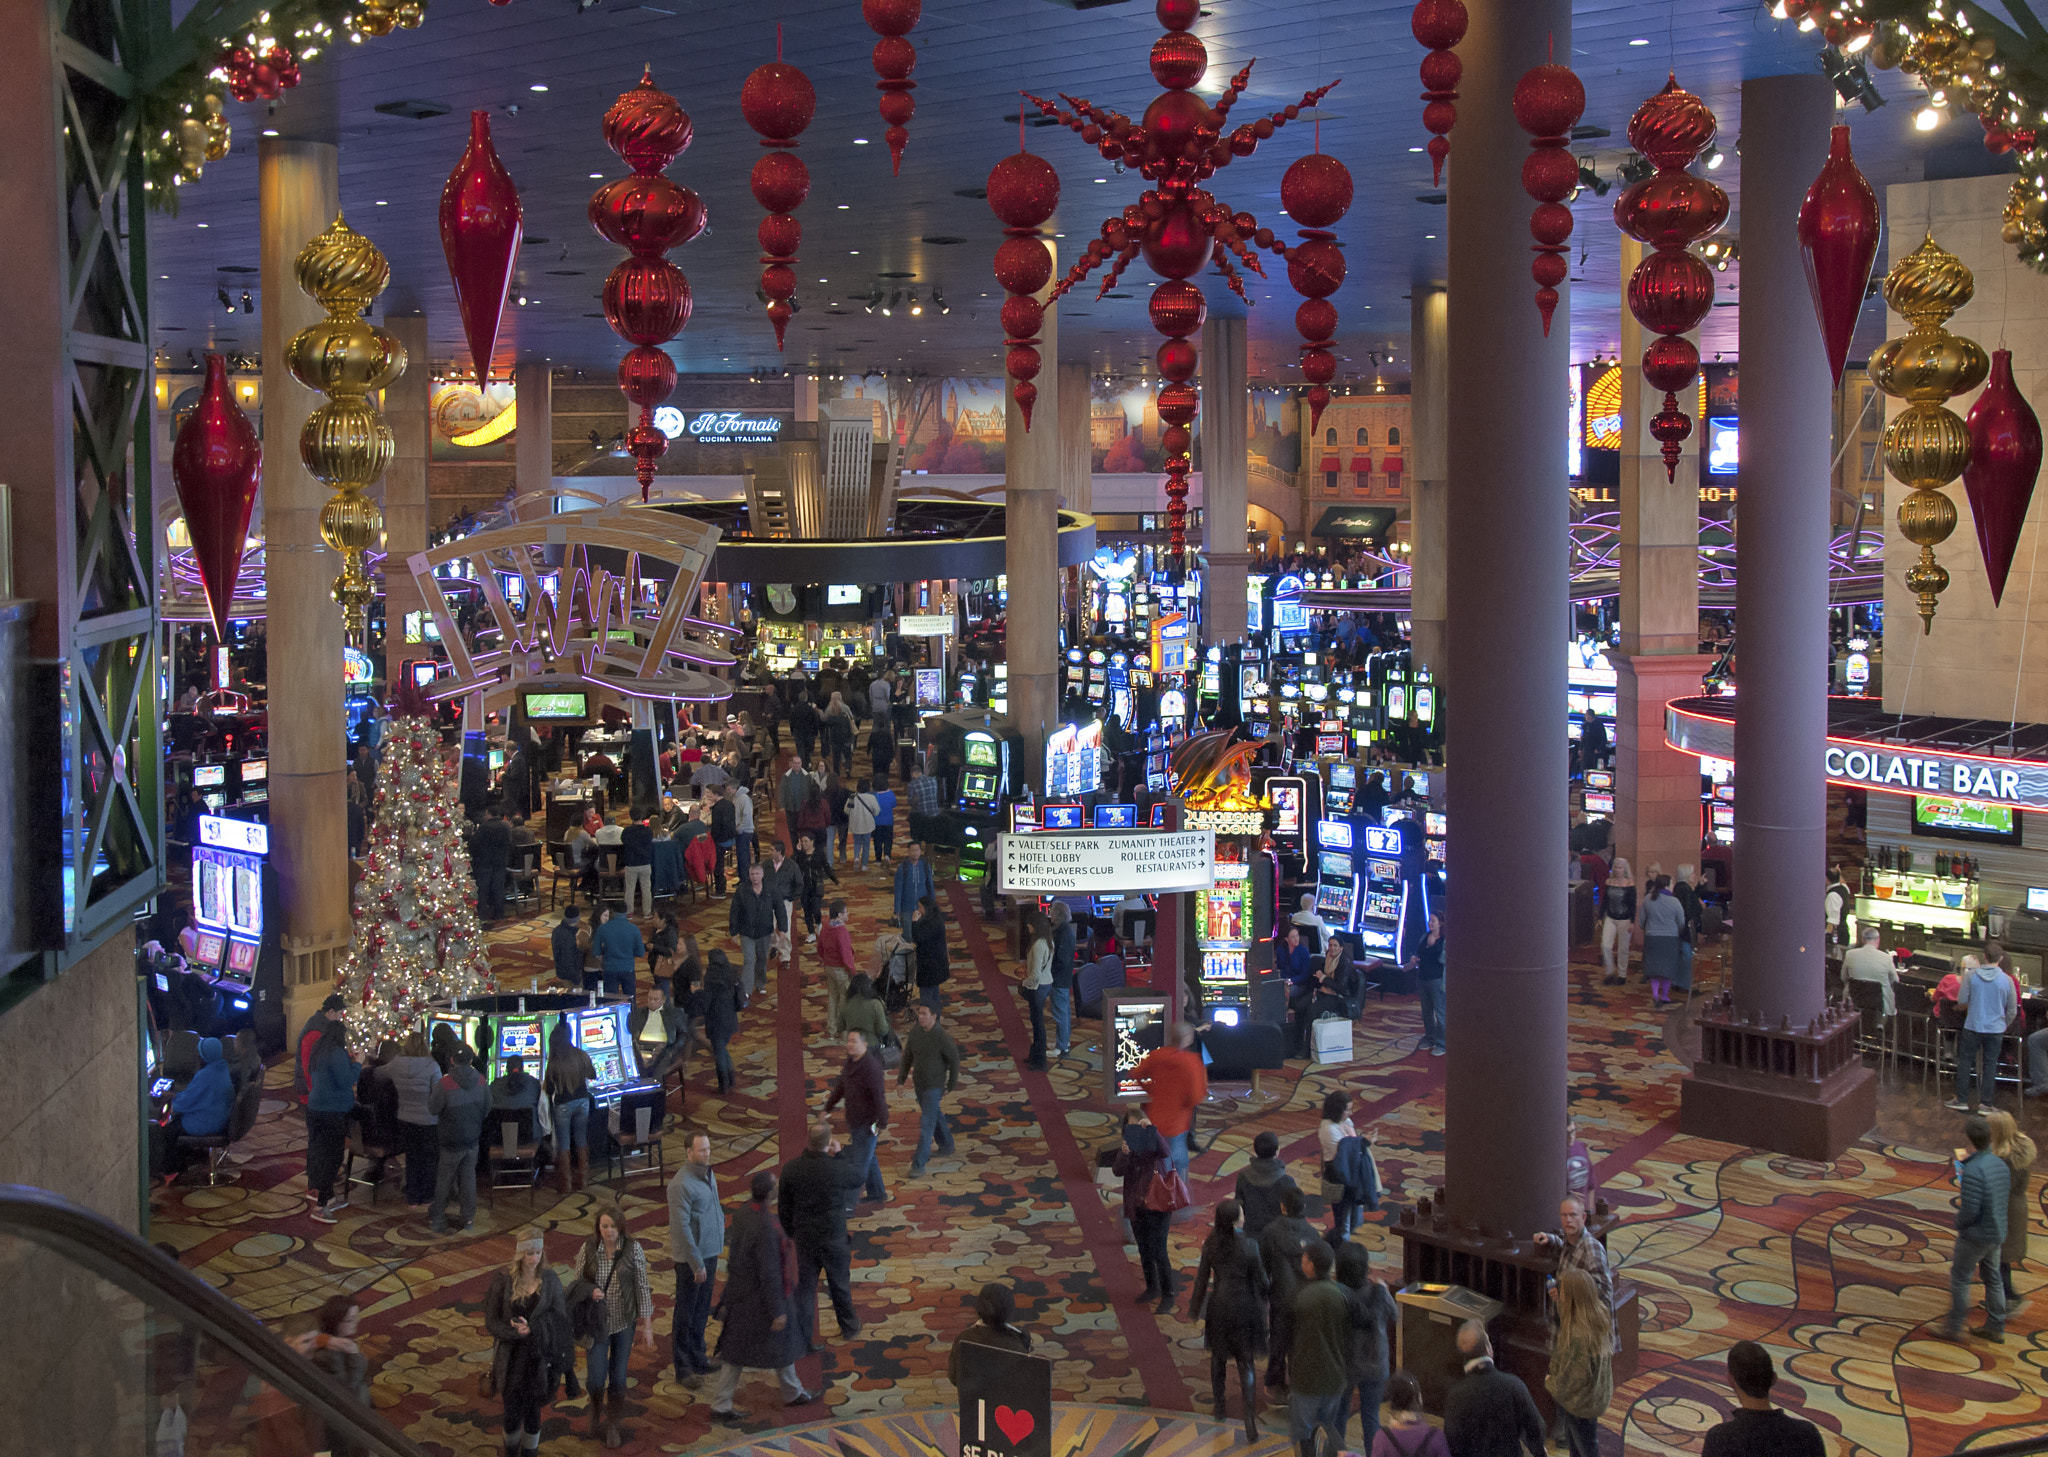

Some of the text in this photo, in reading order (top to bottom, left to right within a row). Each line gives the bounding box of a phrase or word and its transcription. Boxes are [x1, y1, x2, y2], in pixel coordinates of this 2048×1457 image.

[689, 412, 717, 434] Il
[1953, 764, 2021, 800] BAR
[1184, 809, 1264, 824] DUNGEONS
[1019, 840, 1100, 850] VALET/SELF PARK
[1108, 836, 1196, 850] ZUMANITY THEATER
[1019, 853, 1082, 863] HOTEL LOBBY
[1120, 848, 1196, 862] ROLLER COASTER
[1018, 864, 1114, 875] Mlife PLAYERS CLUB
[1136, 860, 1197, 873] RESTAURANTS
[1019, 877, 1076, 888] RESTROOMS
[978, 1398, 985, 1442] I
